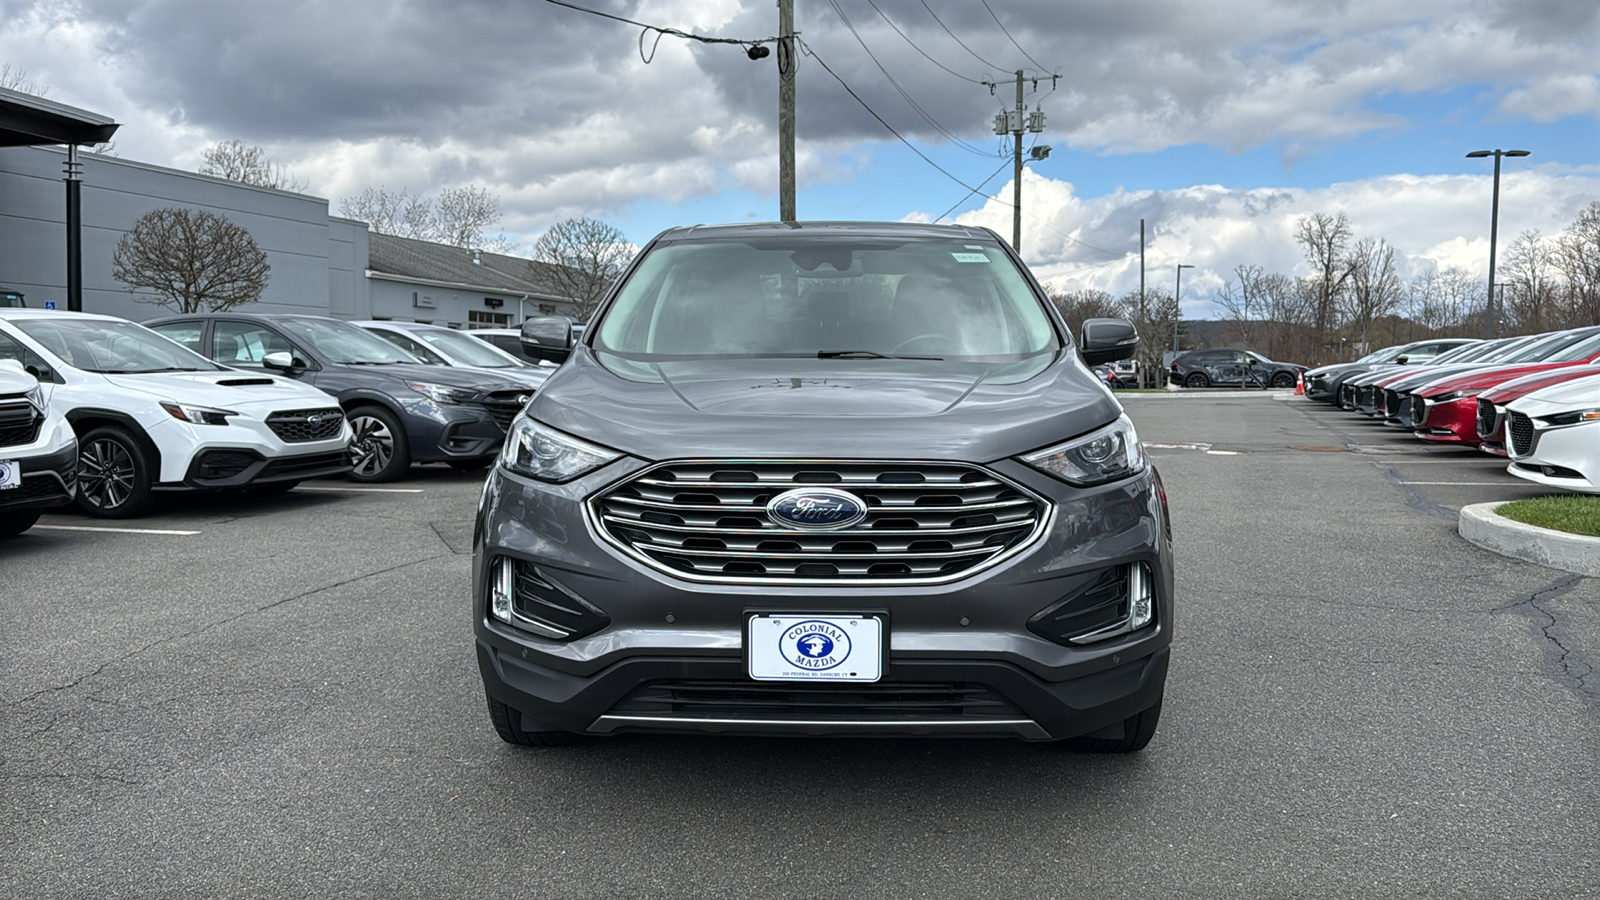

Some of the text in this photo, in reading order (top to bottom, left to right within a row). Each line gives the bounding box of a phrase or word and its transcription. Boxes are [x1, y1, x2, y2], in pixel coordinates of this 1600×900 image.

[791, 497, 843, 519] Ford
[788, 624, 842, 642] COLONIAL
[795, 655, 837, 667] MAZDA
